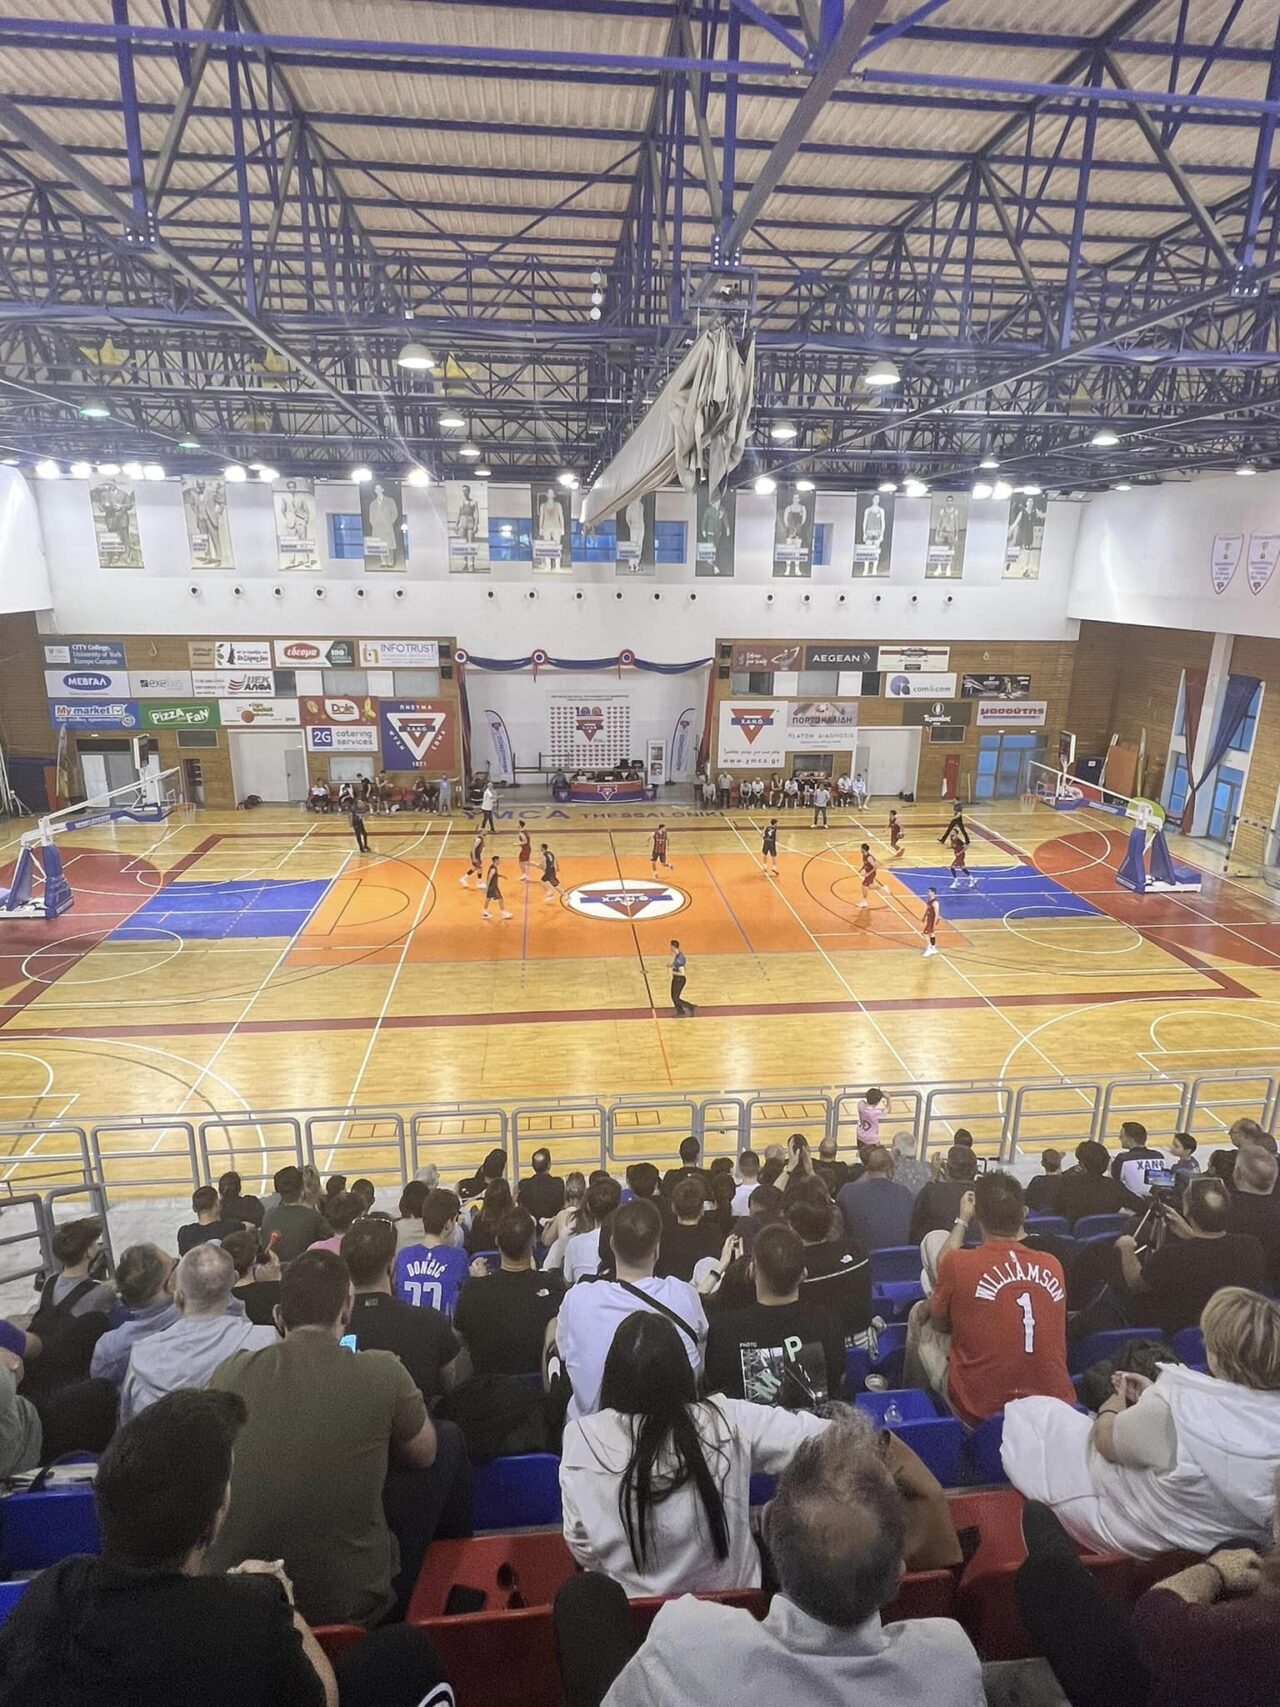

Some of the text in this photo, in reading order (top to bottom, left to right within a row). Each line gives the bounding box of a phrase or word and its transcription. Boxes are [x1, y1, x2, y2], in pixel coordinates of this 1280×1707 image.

[380, 643, 435, 653] INFOTRUST
[812, 654, 860, 663] AEGEAN
[68, 678, 107, 686] ΜΕΒΓΑΛ
[244, 683, 272, 691] ΑΛΦΑ
[73, 705, 110, 714] market
[331, 703, 355, 713] Dole
[792, 716, 853, 725] ΠΟΡΤΟΚΑΛΙΔΗ
[313, 730, 373, 743] 2G catering
[337, 738, 373, 746] services
[581, 811, 726, 819] THESSALONIKI
[406, 1259, 448, 1278] DONČIĆ
[975, 1261, 1064, 1302] WILLIAMSON
[404, 1281, 443, 1312] 77
[1015, 1292, 1036, 1353] 1
[784, 1336, 803, 1363] P
